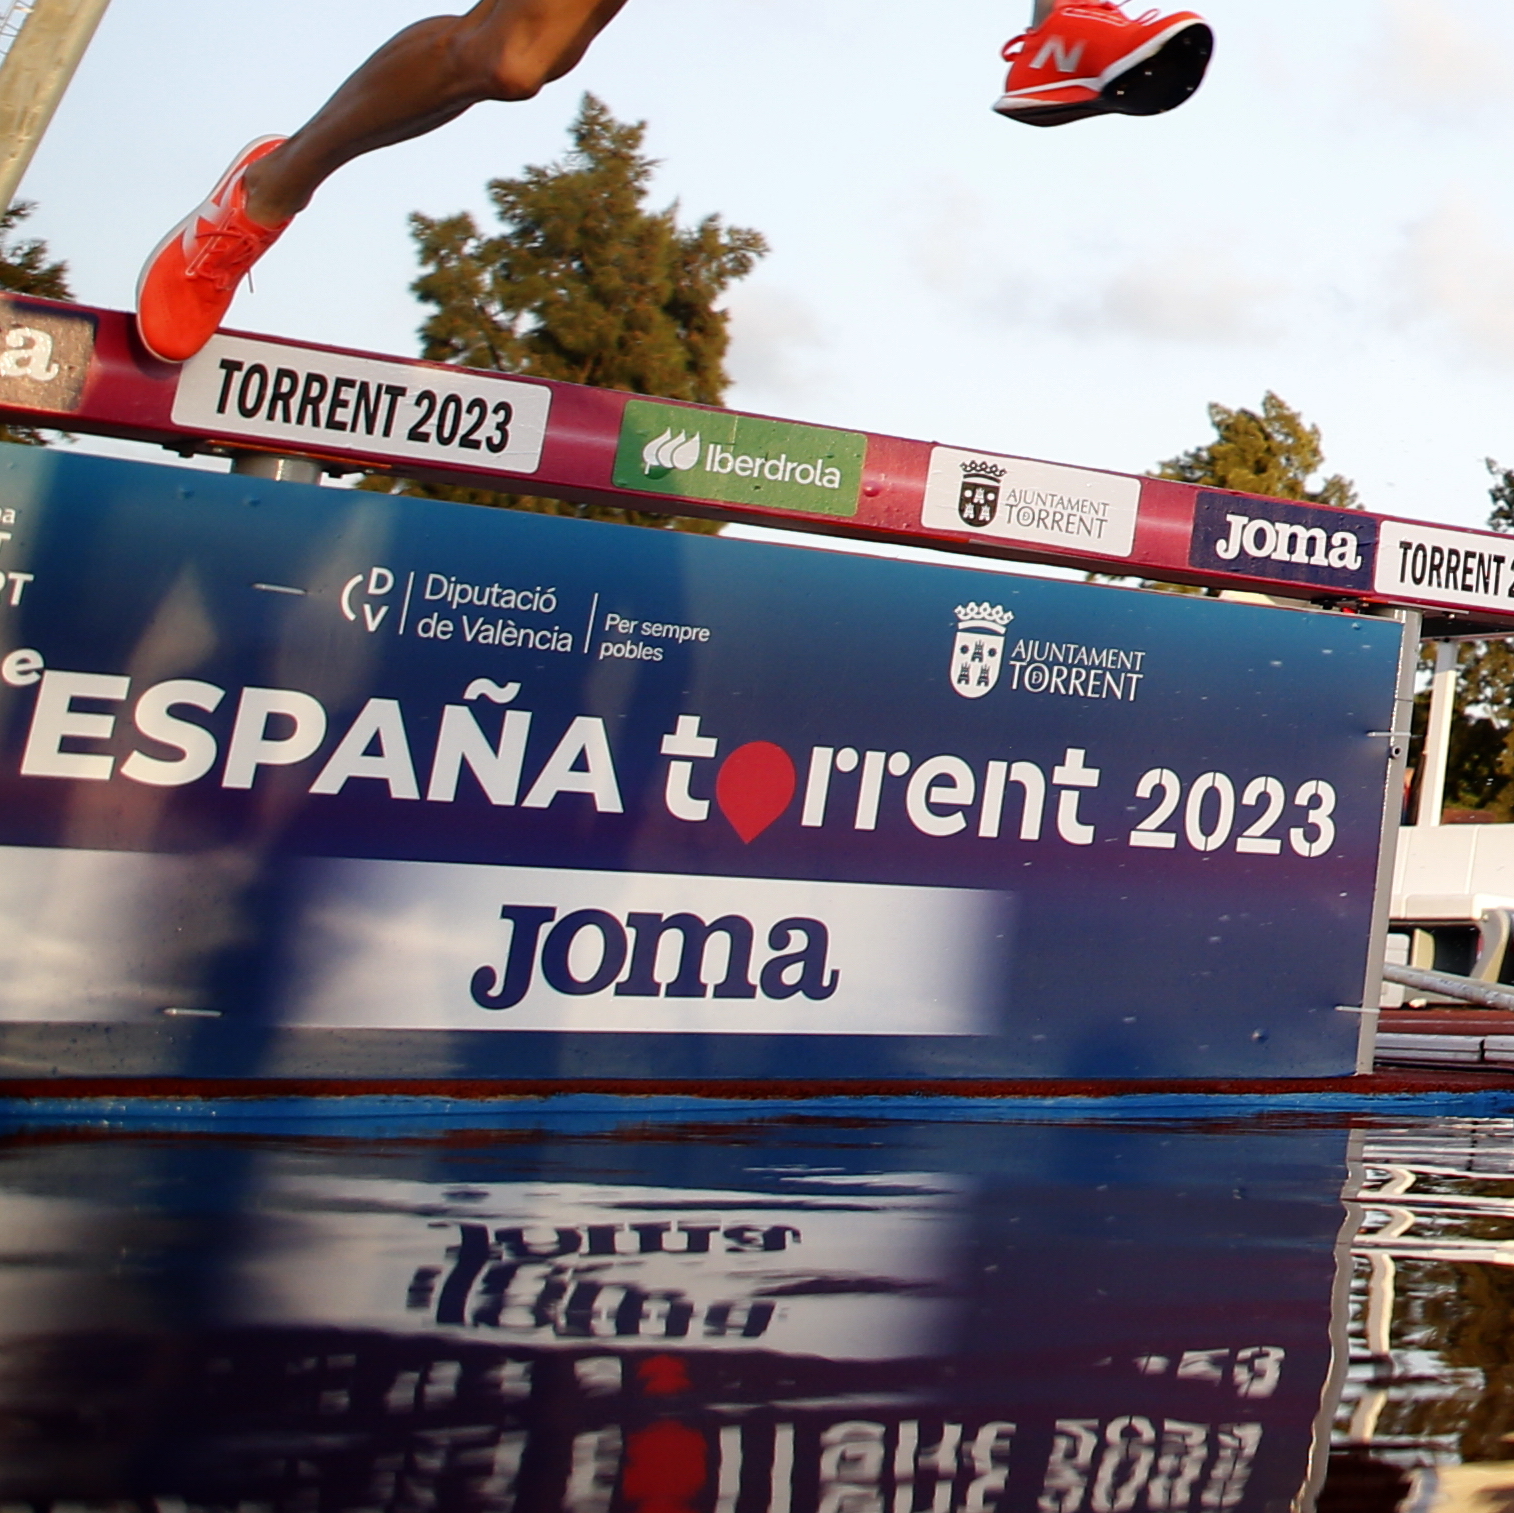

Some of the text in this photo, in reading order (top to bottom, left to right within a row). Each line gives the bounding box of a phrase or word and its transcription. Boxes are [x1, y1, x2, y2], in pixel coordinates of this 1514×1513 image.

[216, 358, 514, 453] TORRENT 2023
[704, 442, 842, 490] Iberdrola
[1004, 503, 1109, 539] TORRENT
[1006, 488, 1110, 517] AJUNTAMENT
[1215, 513, 1363, 572] Joma
[0, 570, 35, 607] T
[1398, 540, 1505, 596] TORRENT
[423, 572, 558, 614] Diputació
[416, 612, 574, 653] de València
[603, 612, 711, 644] Per sempre
[598, 641, 664, 662] pobles
[1010, 638, 1146, 671] AJUNTAMENT
[1008, 659, 1144, 702] TORRENT
[20, 669, 624, 814] ESPAÑA
[1128, 767, 1338, 858] 2023
[470, 904, 840, 1011] Joma
